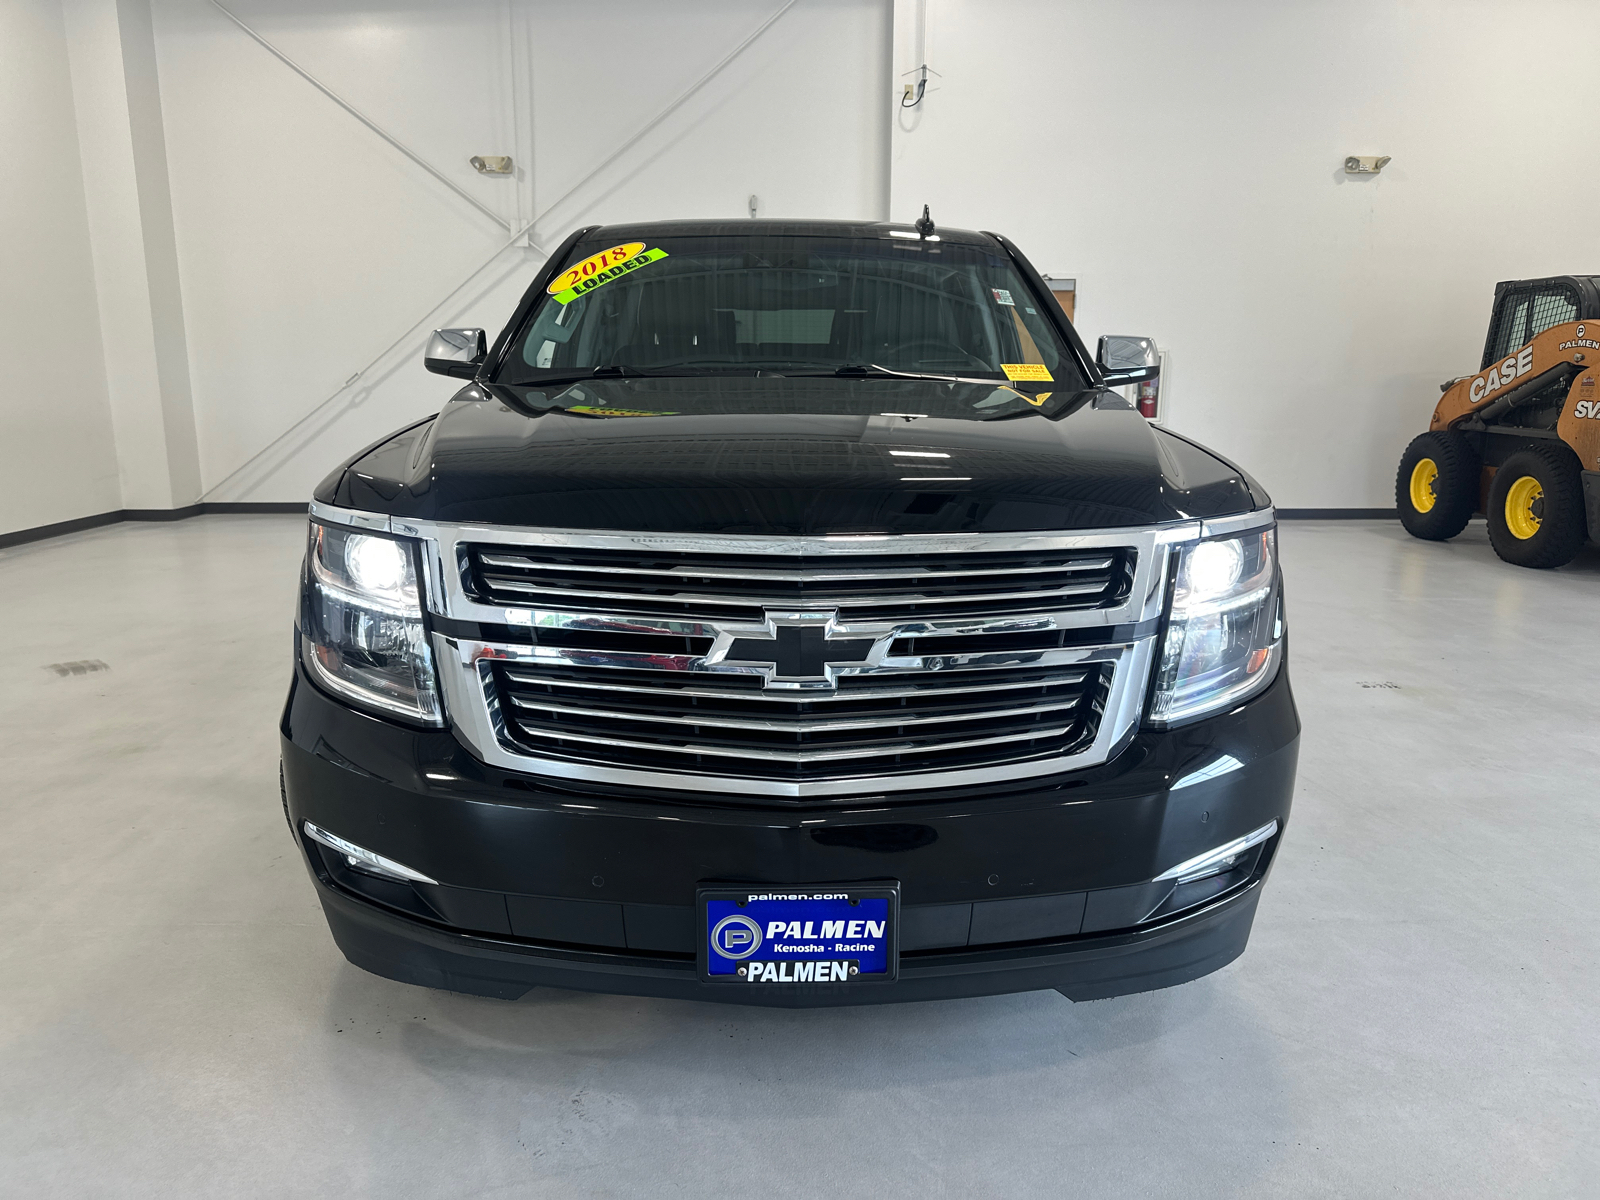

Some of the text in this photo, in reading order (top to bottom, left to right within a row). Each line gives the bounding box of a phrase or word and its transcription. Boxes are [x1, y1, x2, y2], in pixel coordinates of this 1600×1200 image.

[566, 247, 627, 286] 2018
[572, 254, 652, 295] LOADED
[1559, 340, 1600, 350] PALMEN
[1469, 344, 1533, 403] CASE
[748, 893, 849, 902] palmen.com
[766, 920, 886, 939] PALMEN
[774, 943, 825, 953] Kenosha
[835, 943, 875, 952] Racine
[747, 961, 849, 982] PALMEN
